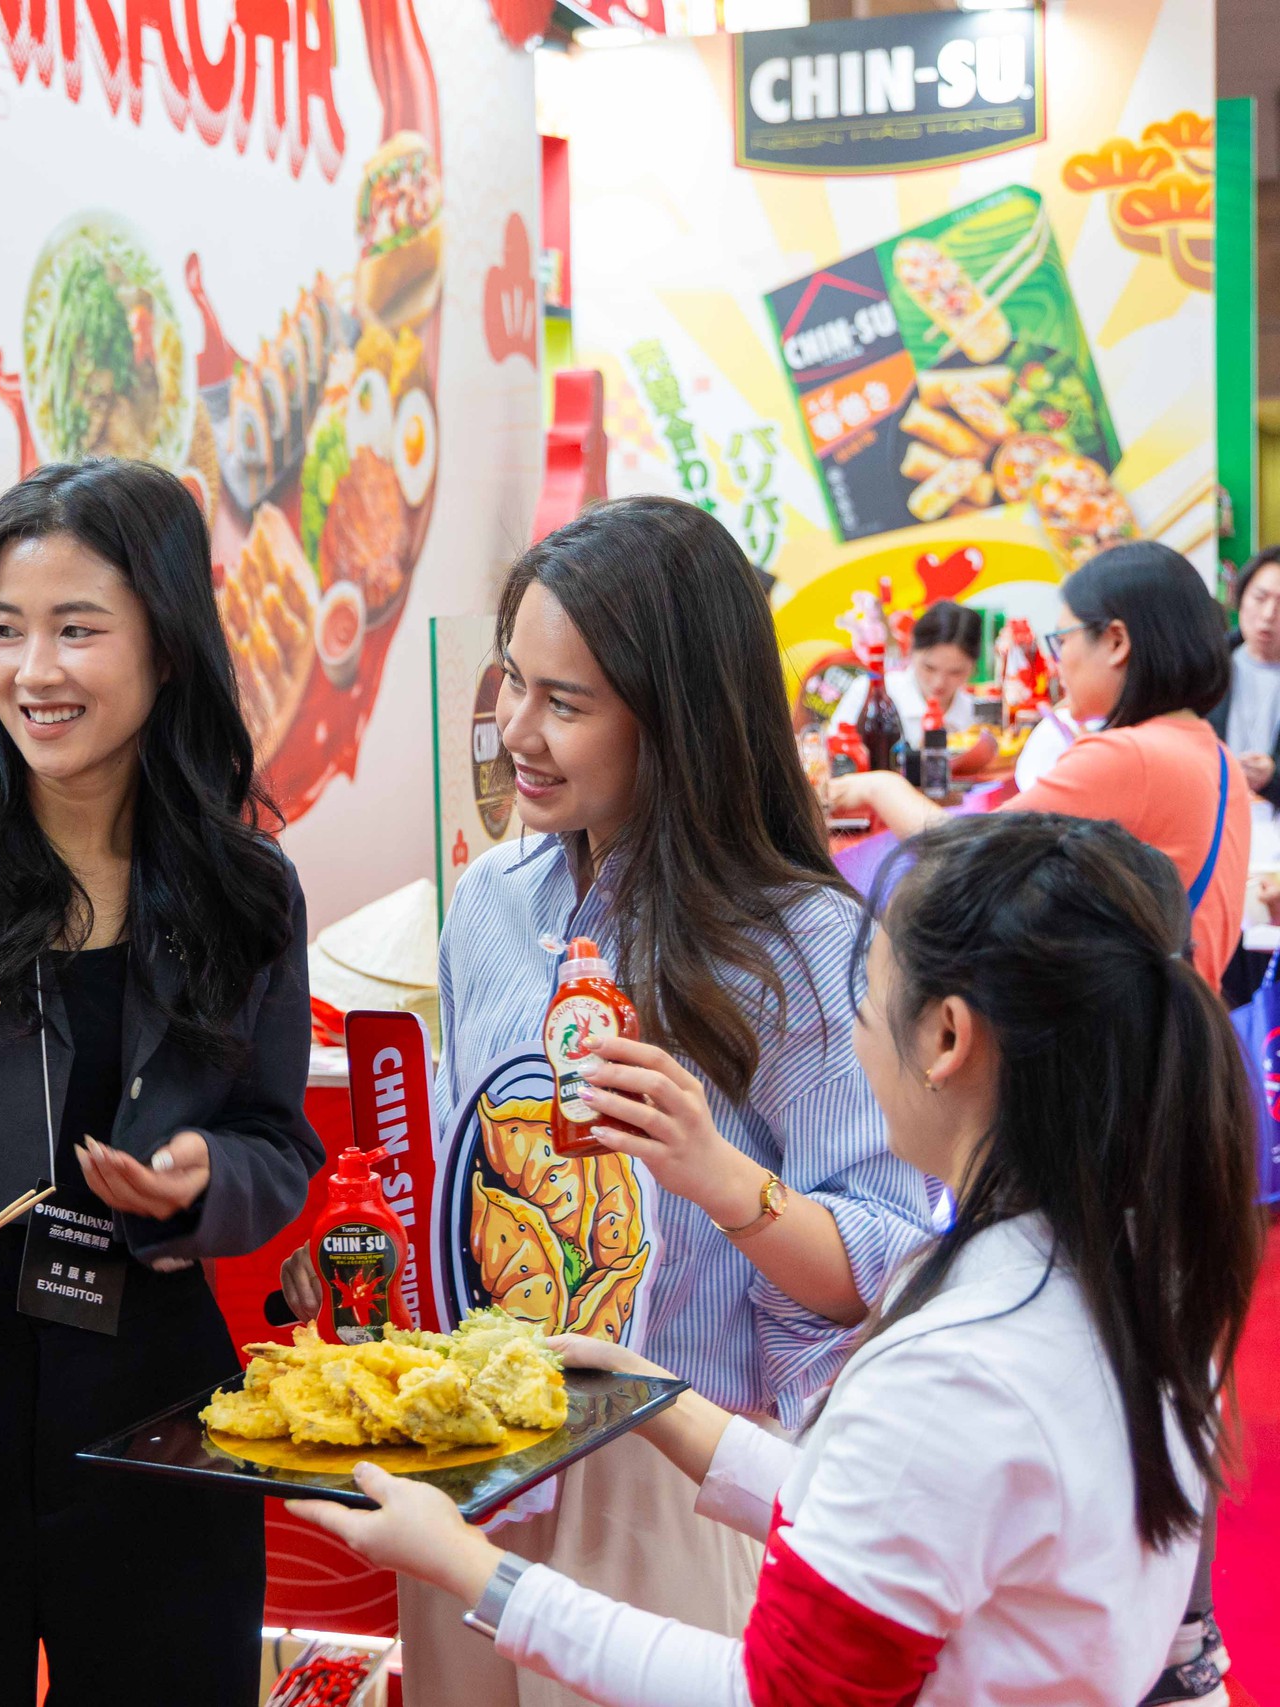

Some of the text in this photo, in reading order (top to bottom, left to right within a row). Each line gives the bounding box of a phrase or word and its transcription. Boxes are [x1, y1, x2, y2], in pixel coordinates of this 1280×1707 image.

[750, 34, 1026, 124] CHIN-SU
[372, 1046, 416, 1229] CHIN-SU
[44, 1204, 79, 1223] FOODEX
[78, 1213, 104, 1229] JAPAN
[323, 1235, 386, 1251] CHIN-SU
[51, 1262, 96, 1284] 出展者
[37, 1279, 103, 1304] EXHIBITOR
